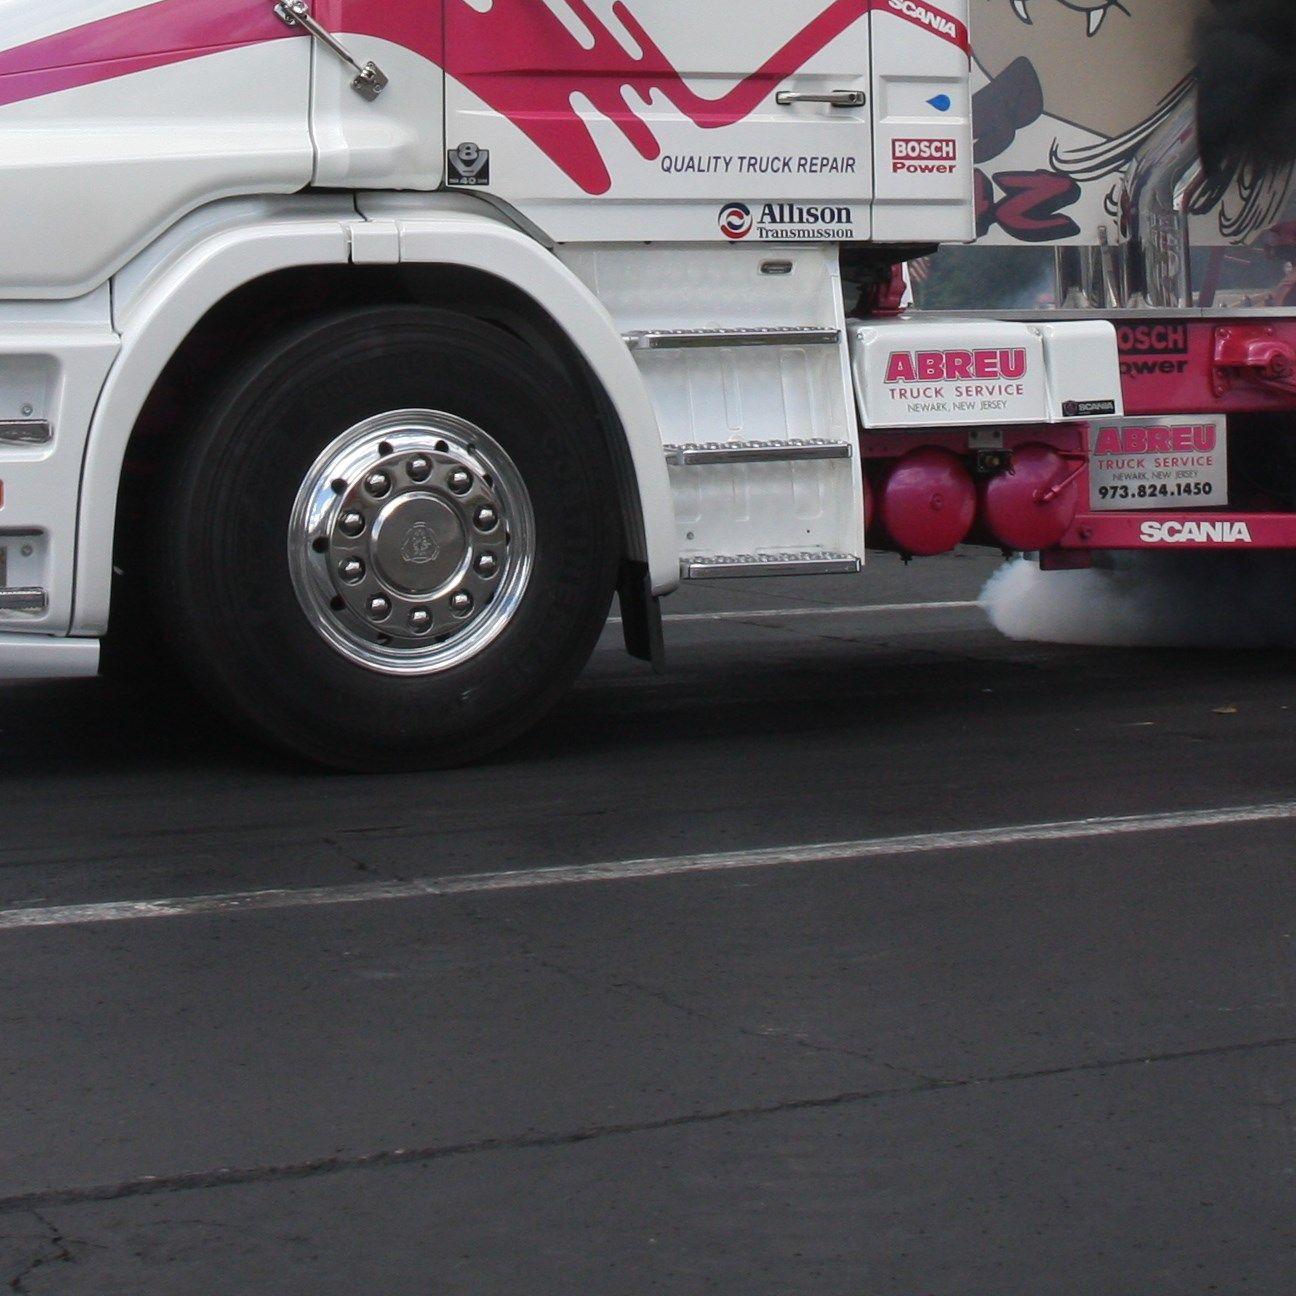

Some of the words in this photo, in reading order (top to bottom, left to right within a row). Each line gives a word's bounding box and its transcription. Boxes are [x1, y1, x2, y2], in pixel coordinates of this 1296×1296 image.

[894, 140, 955, 158] BOSCH
[660, 155, 732, 173] QUALITY
[738, 156, 793, 173] TRUCK
[797, 156, 856, 173] REPAIR
[892, 161, 957, 174] Power
[757, 203, 853, 224] Allison
[756, 226, 854, 239] Transmission
[1117, 324, 1185, 351] OSCH
[884, 347, 1028, 384] ABREU
[1119, 360, 1188, 375] ower
[889, 387, 944, 400] TRUCK
[955, 384, 1024, 397] SERVICE
[907, 402, 951, 412] NEWARK,
[953, 401, 975, 411] NEW
[980, 400, 1008, 411] JERSEY
[1094, 424, 1217, 456] ABREU
[1098, 458, 1145, 470] TRUCK
[1154, 456, 1213, 467] SERVICE
[1112, 472, 1149, 481] NEWARK,
[1152, 471, 1171, 480] NEW
[1174, 470, 1199, 479] JERSEY
[1098, 481, 1213, 499] 973.824.1450
[1139, 520, 1252, 543] SCANIA
